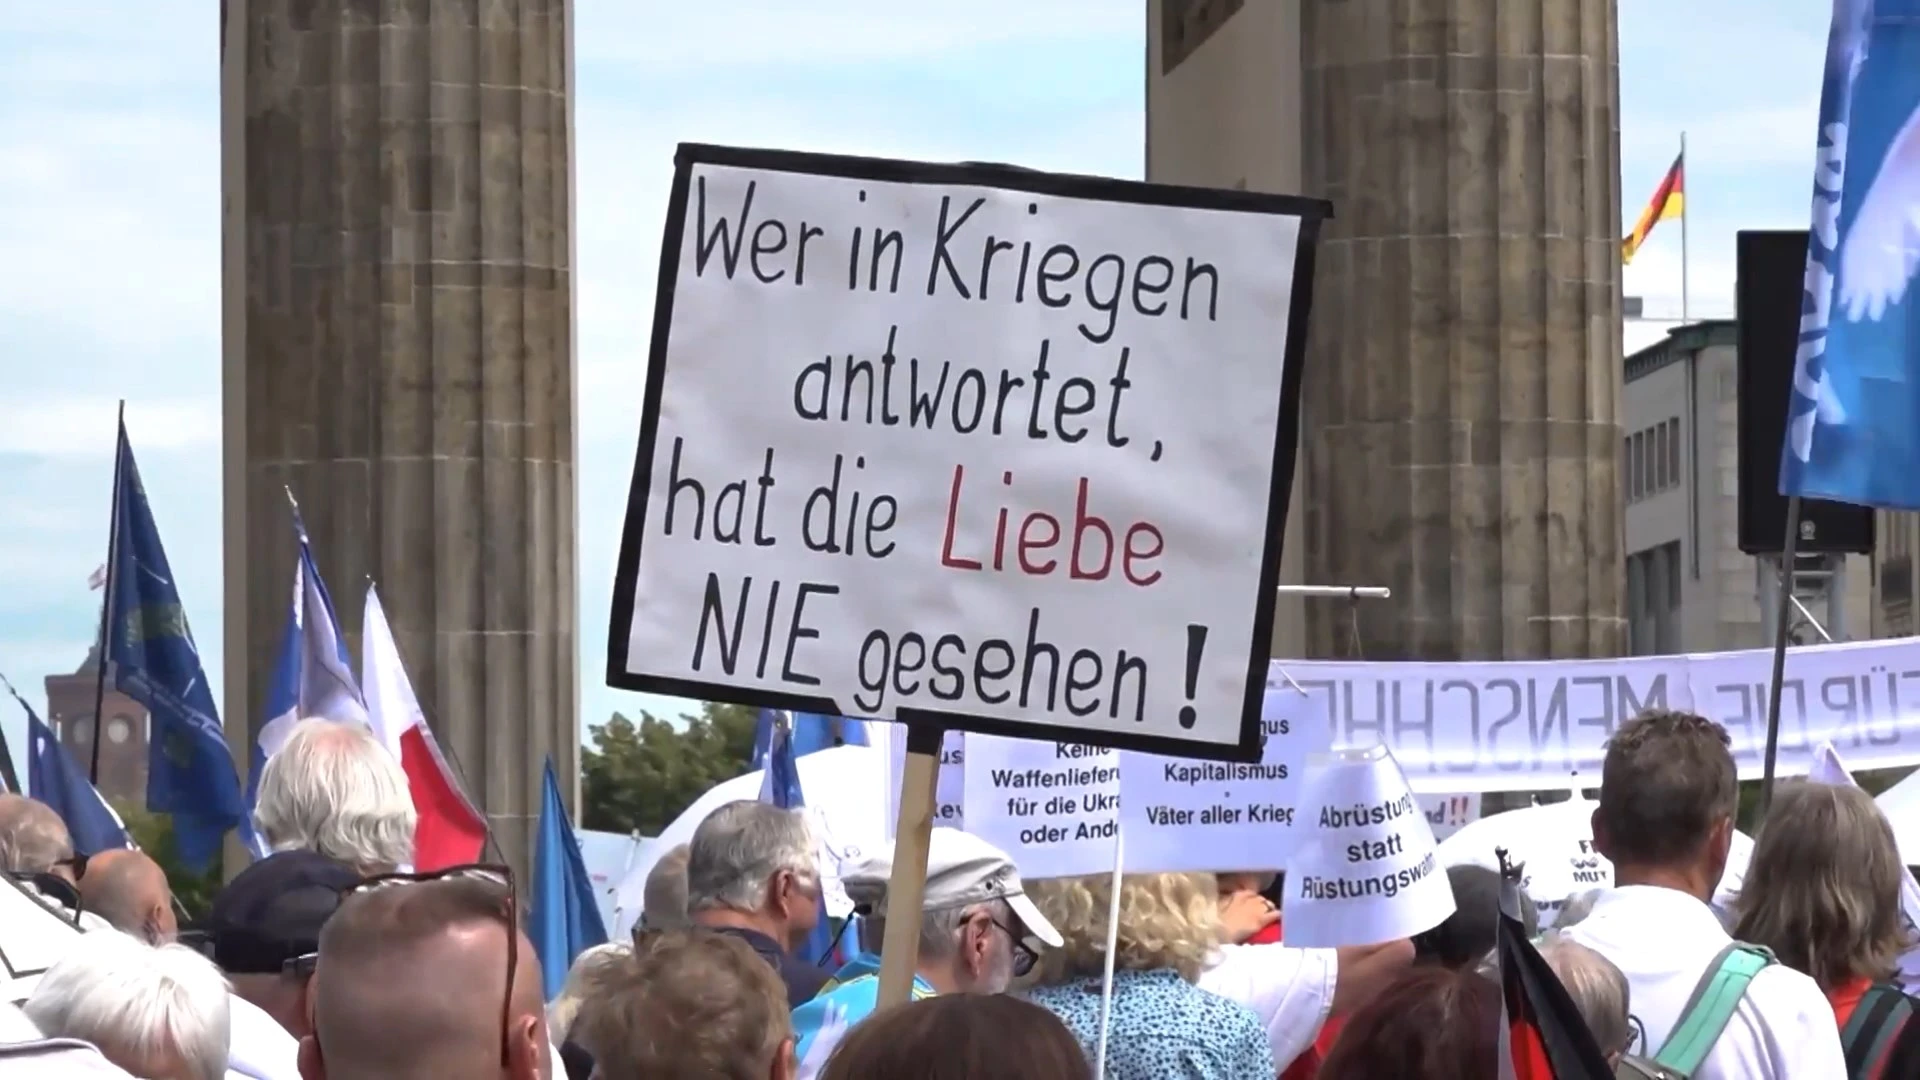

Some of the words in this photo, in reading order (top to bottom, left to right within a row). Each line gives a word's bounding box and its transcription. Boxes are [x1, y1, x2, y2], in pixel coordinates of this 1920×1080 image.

[696, 176, 824, 285] Wer
[850, 190, 903, 293] in
[927, 196, 1218, 343] Kriegen
[795, 325, 1162, 461] antwortet,
[664, 437, 776, 546] hat
[803, 454, 898, 558] die
[942, 464, 1163, 586] Liebe
[692, 573, 839, 685] NIE
[1164, 762, 1288, 786] Kapitalismus
[1008, 798, 1038, 816] für
[1045, 797, 1077, 815] die
[1146, 806, 1194, 825] Väter
[1200, 805, 1242, 824] aller
[1020, 825, 1068, 844] oder
[1347, 833, 1403, 863] statt
